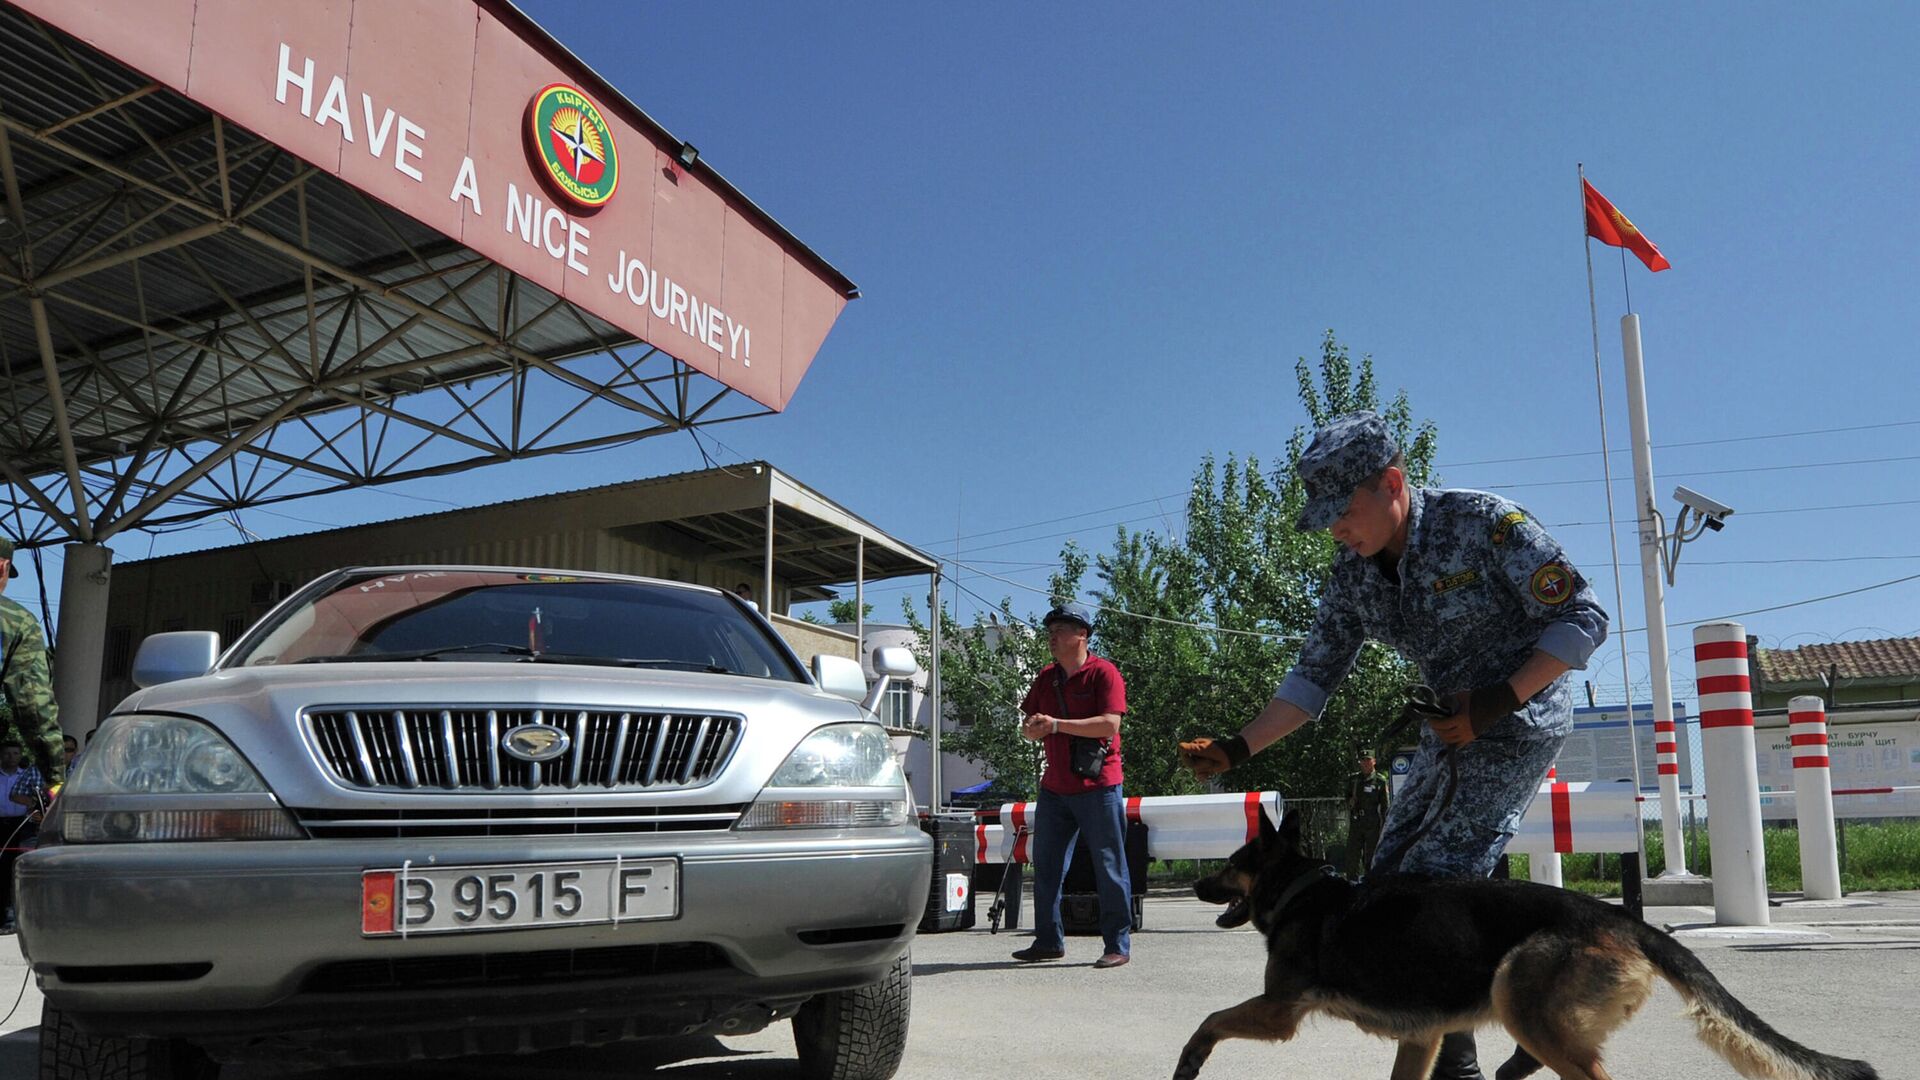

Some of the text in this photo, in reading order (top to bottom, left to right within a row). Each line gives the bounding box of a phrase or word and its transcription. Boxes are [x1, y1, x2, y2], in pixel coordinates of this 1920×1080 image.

[555, 92, 605, 133] КЫРГЫЗ
[551, 160, 600, 198] БАЖЫСЫ
[275, 42, 751, 367] HAVE A NICE JOURNEY!
[1848, 731, 1878, 740] БУРЧУ
[1875, 738, 1897, 746] ЩИТ
[398, 866, 654, 925] B 9515 F
